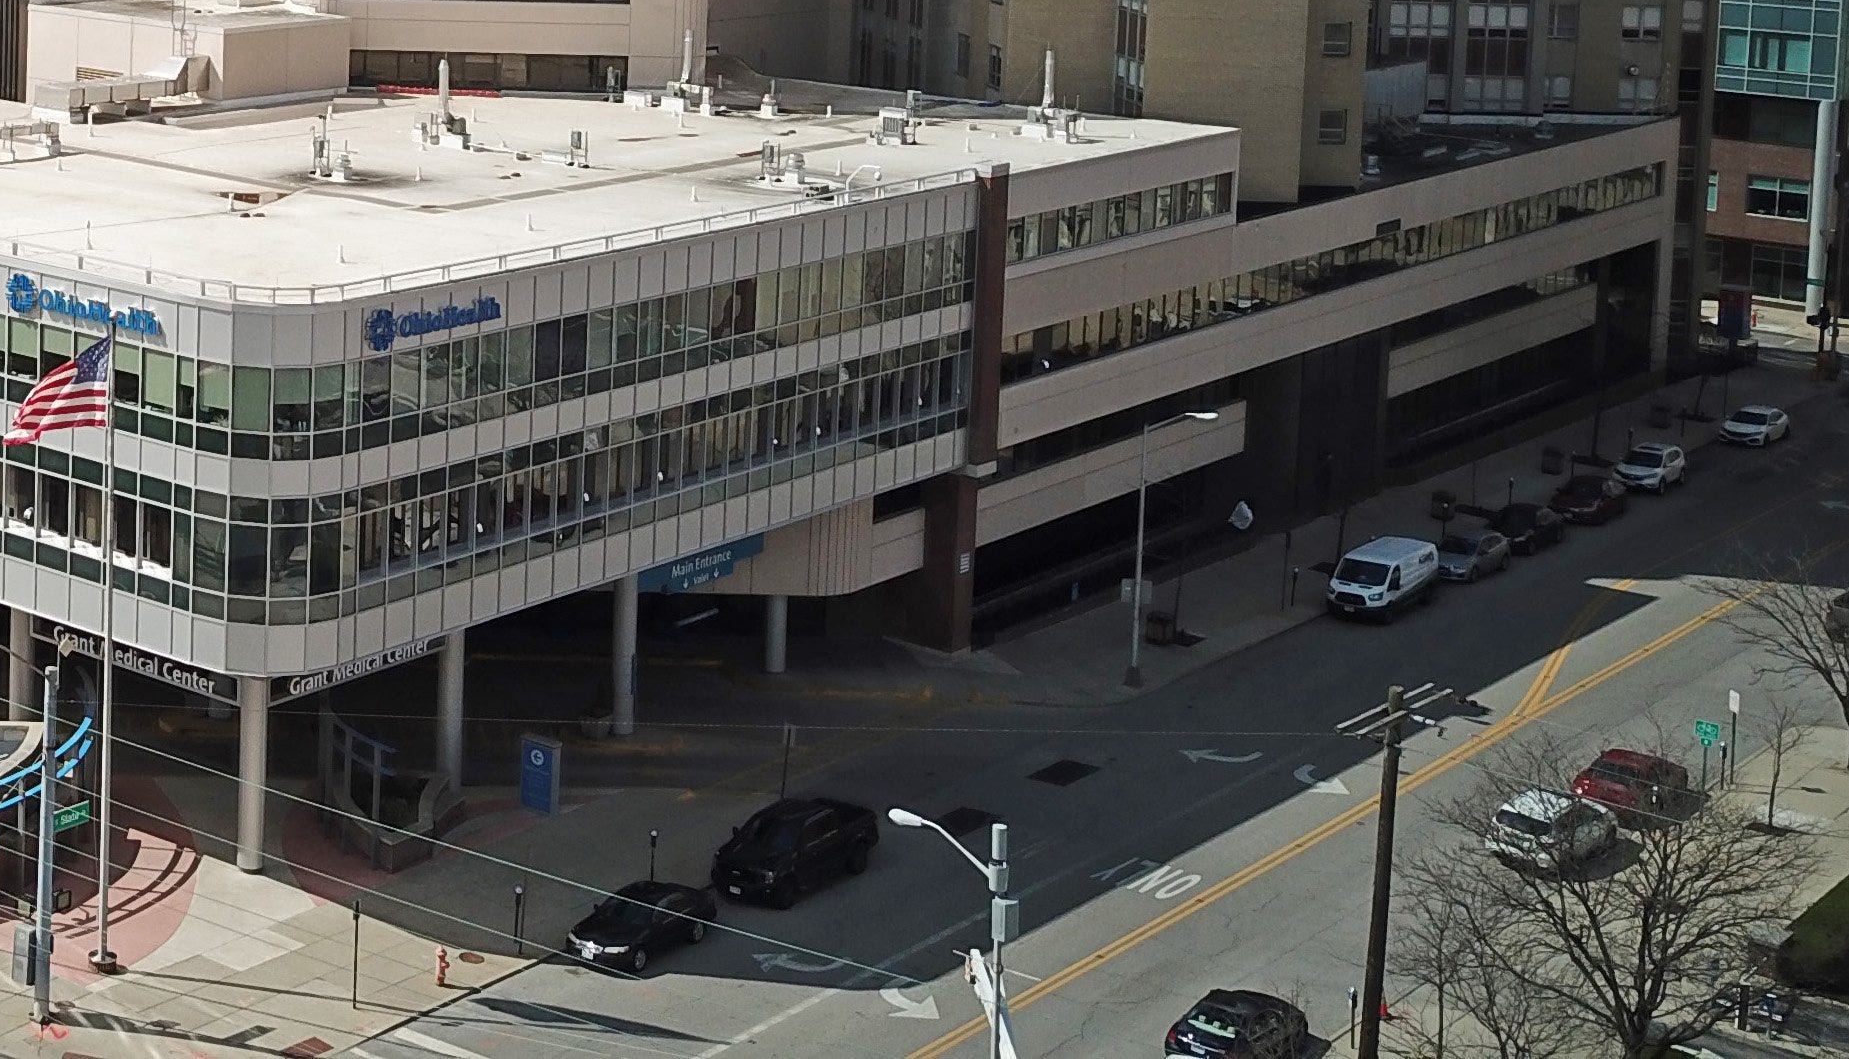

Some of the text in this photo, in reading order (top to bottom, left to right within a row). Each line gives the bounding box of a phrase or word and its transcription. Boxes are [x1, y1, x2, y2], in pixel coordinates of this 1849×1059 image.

[39, 288, 161, 335] OhioHealth
[671, 550, 732, 579] Main Entrance
[162, 662, 216, 694] Center
[289, 640, 430, 695] Grant Medical Center
